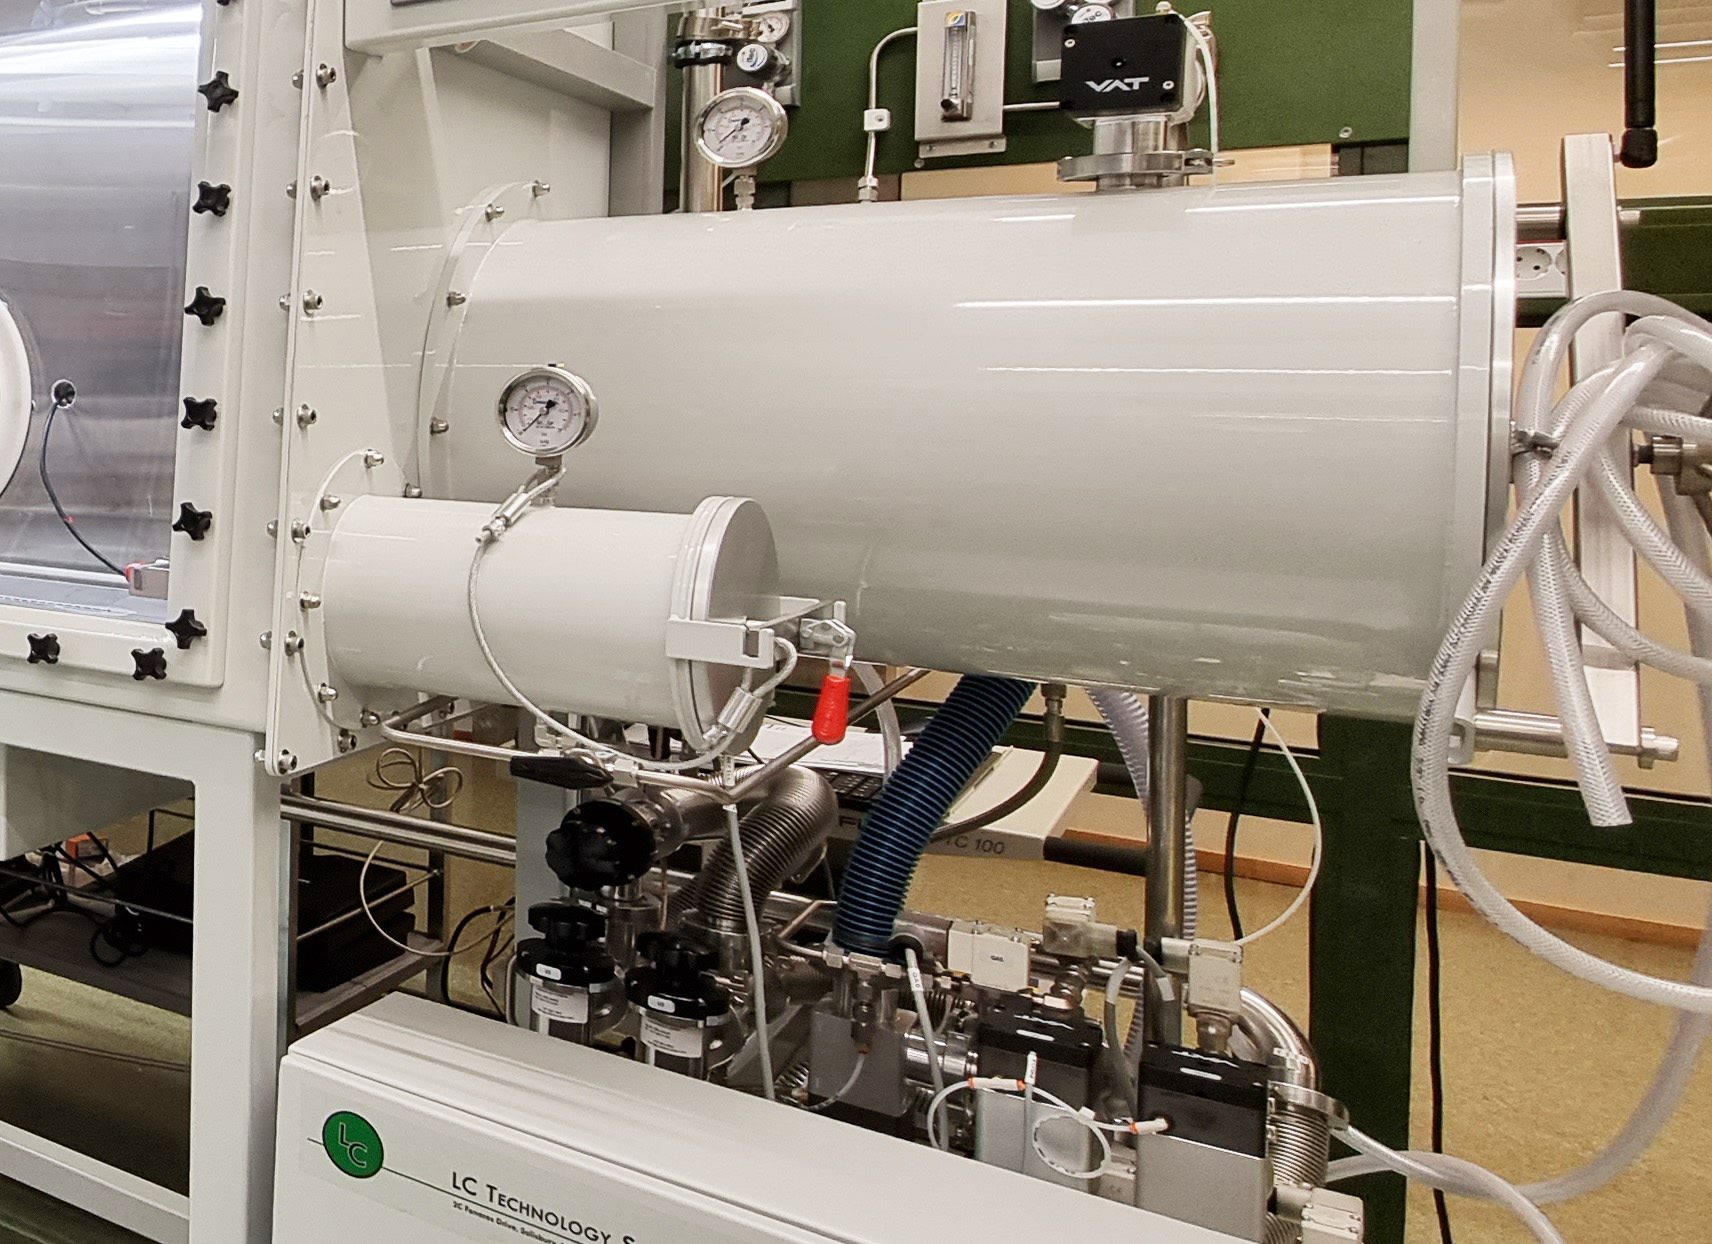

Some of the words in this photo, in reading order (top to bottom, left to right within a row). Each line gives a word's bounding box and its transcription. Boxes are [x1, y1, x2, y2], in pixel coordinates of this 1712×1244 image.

[1085, 76, 1149, 93] VAT
[975, 838, 1006, 855] 100
[338, 1122, 368, 1168] LC
[452, 1172, 478, 1196] LC
